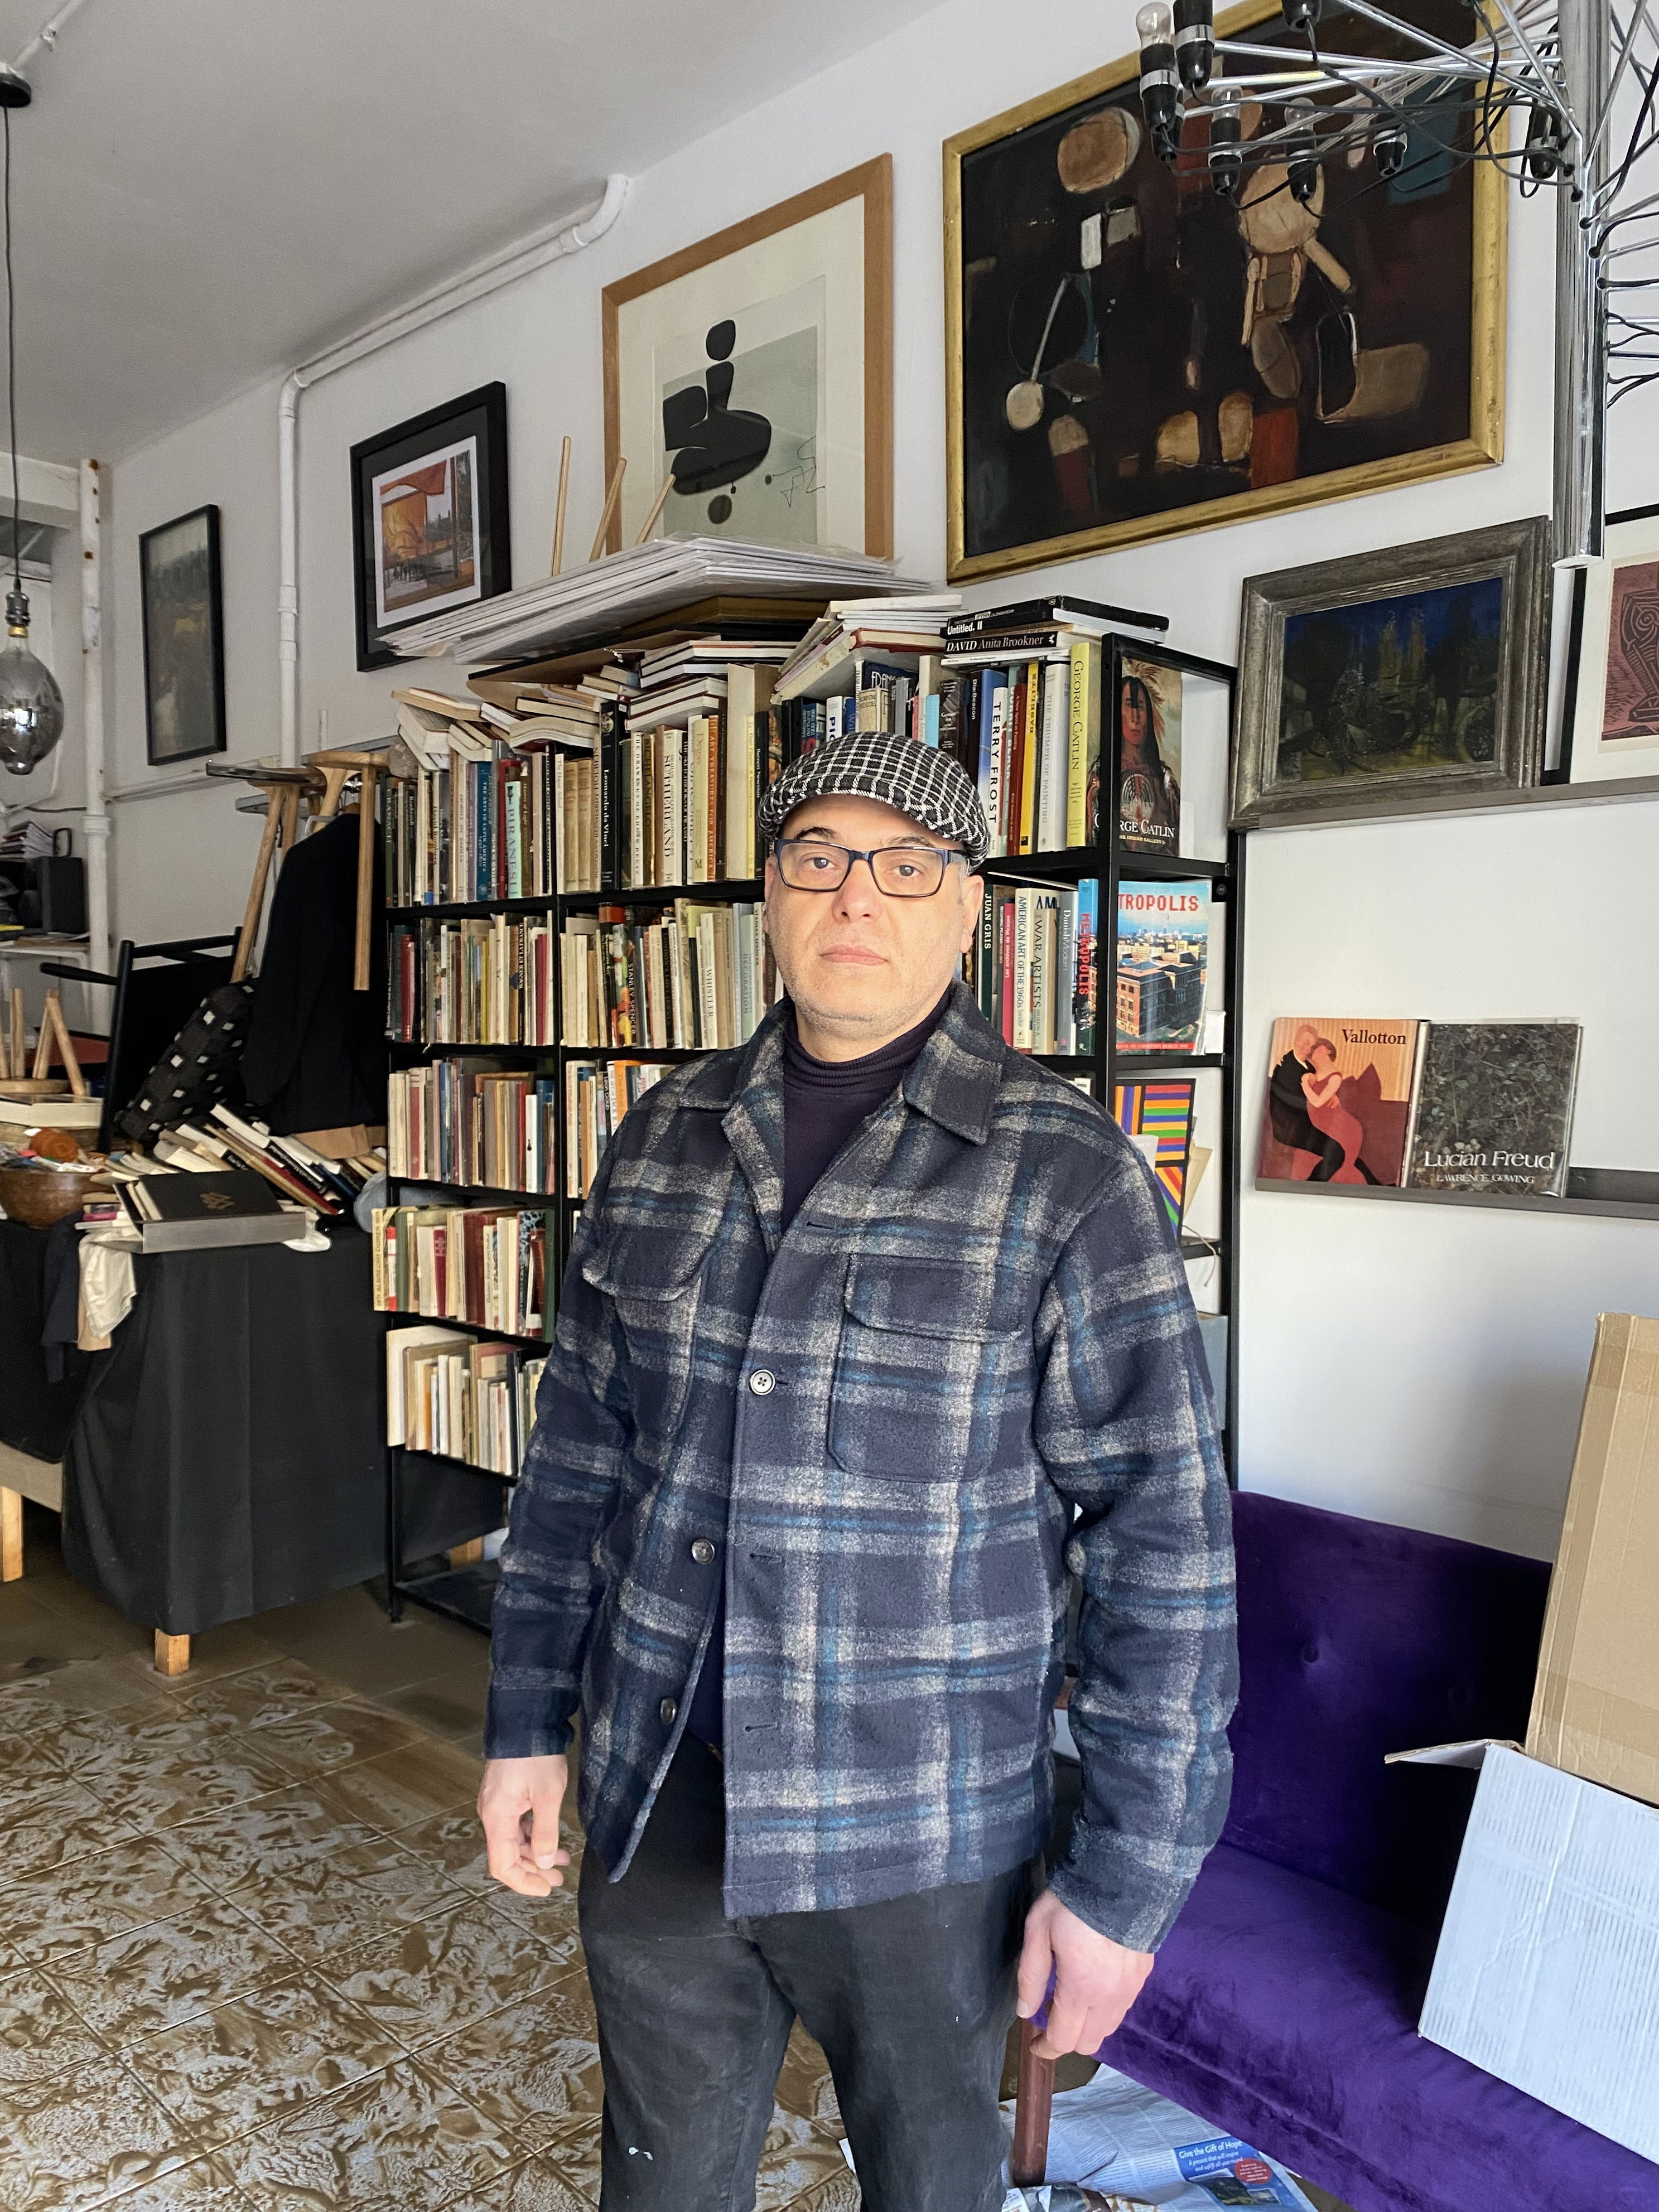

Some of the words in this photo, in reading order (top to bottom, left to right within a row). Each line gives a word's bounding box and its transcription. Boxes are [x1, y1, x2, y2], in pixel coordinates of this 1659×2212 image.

[947, 622, 975, 635] Untitled.
[947, 641, 977, 651] DAVID
[978, 638, 1001, 649] Anita
[1003, 636, 1044, 648] Brookner
[1073, 661, 1083, 718] GEORGE
[992, 702, 1001, 758] TERRY
[695, 732, 704, 765] Degas
[1072, 722, 1083, 770] CATLIN
[1044, 764, 1049, 776] OF
[989, 767, 998, 823] FROST
[604, 812, 609, 822] da
[1119, 820, 1139, 833] RGE
[1141, 819, 1175, 838] CATLIN
[507, 808, 517, 886] PIRANESI
[1118, 894, 1199, 911] TROPOLIS
[1018, 896, 1026, 941] AMERICAN
[1005, 935, 1010, 943] de
[1034, 920, 1043, 953] WAR
[1078, 914, 1091, 995] METROPOLIS
[1017, 960, 1025, 971] OF
[1342, 1028, 1407, 1045] Vallotton
[1424, 1151, 1487, 1169] Lucian
[1491, 1150, 1556, 1170] Freud
[1436, 1173, 1489, 1184] LAWRENCE
[1492, 1174, 1535, 1185] GOWING
[1179, 2151, 1194, 2159] Give
[1194, 2148, 1204, 2157] the
[1205, 2144, 1217, 2153] Gift
[1218, 2142, 1224, 2150] of
[1225, 2140, 1242, 2151] Hope
[1193, 2157, 1207, 2166] present
[1204, 2162, 1215, 2170] uplift
